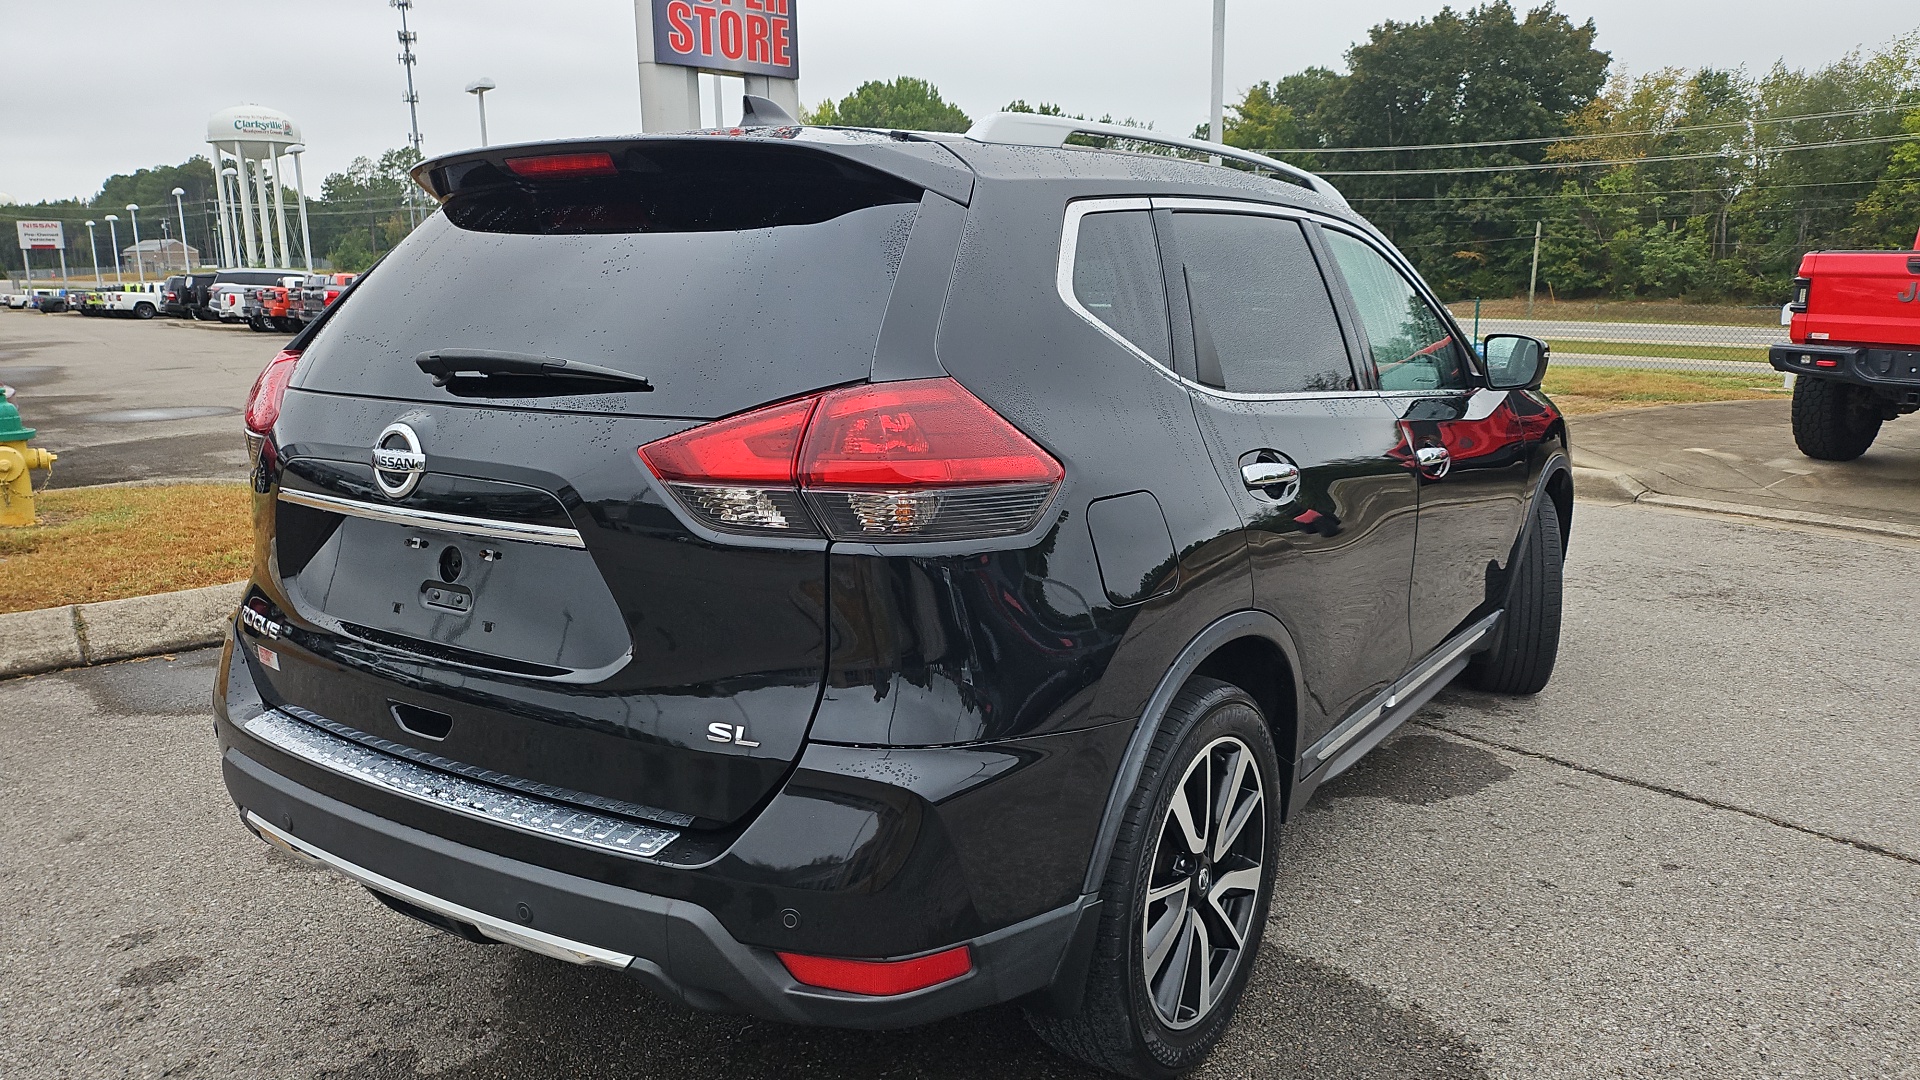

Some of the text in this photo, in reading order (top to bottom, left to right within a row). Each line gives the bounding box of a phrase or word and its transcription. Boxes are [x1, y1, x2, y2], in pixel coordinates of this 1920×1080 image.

[667, 0, 791, 67] STORE
[234, 119, 283, 131] Clarksville
[1897, 281, 1920, 303] J
[372, 453, 415, 469] NISSAN
[242, 605, 281, 640] ROGUE
[706, 722, 761, 748] SL
